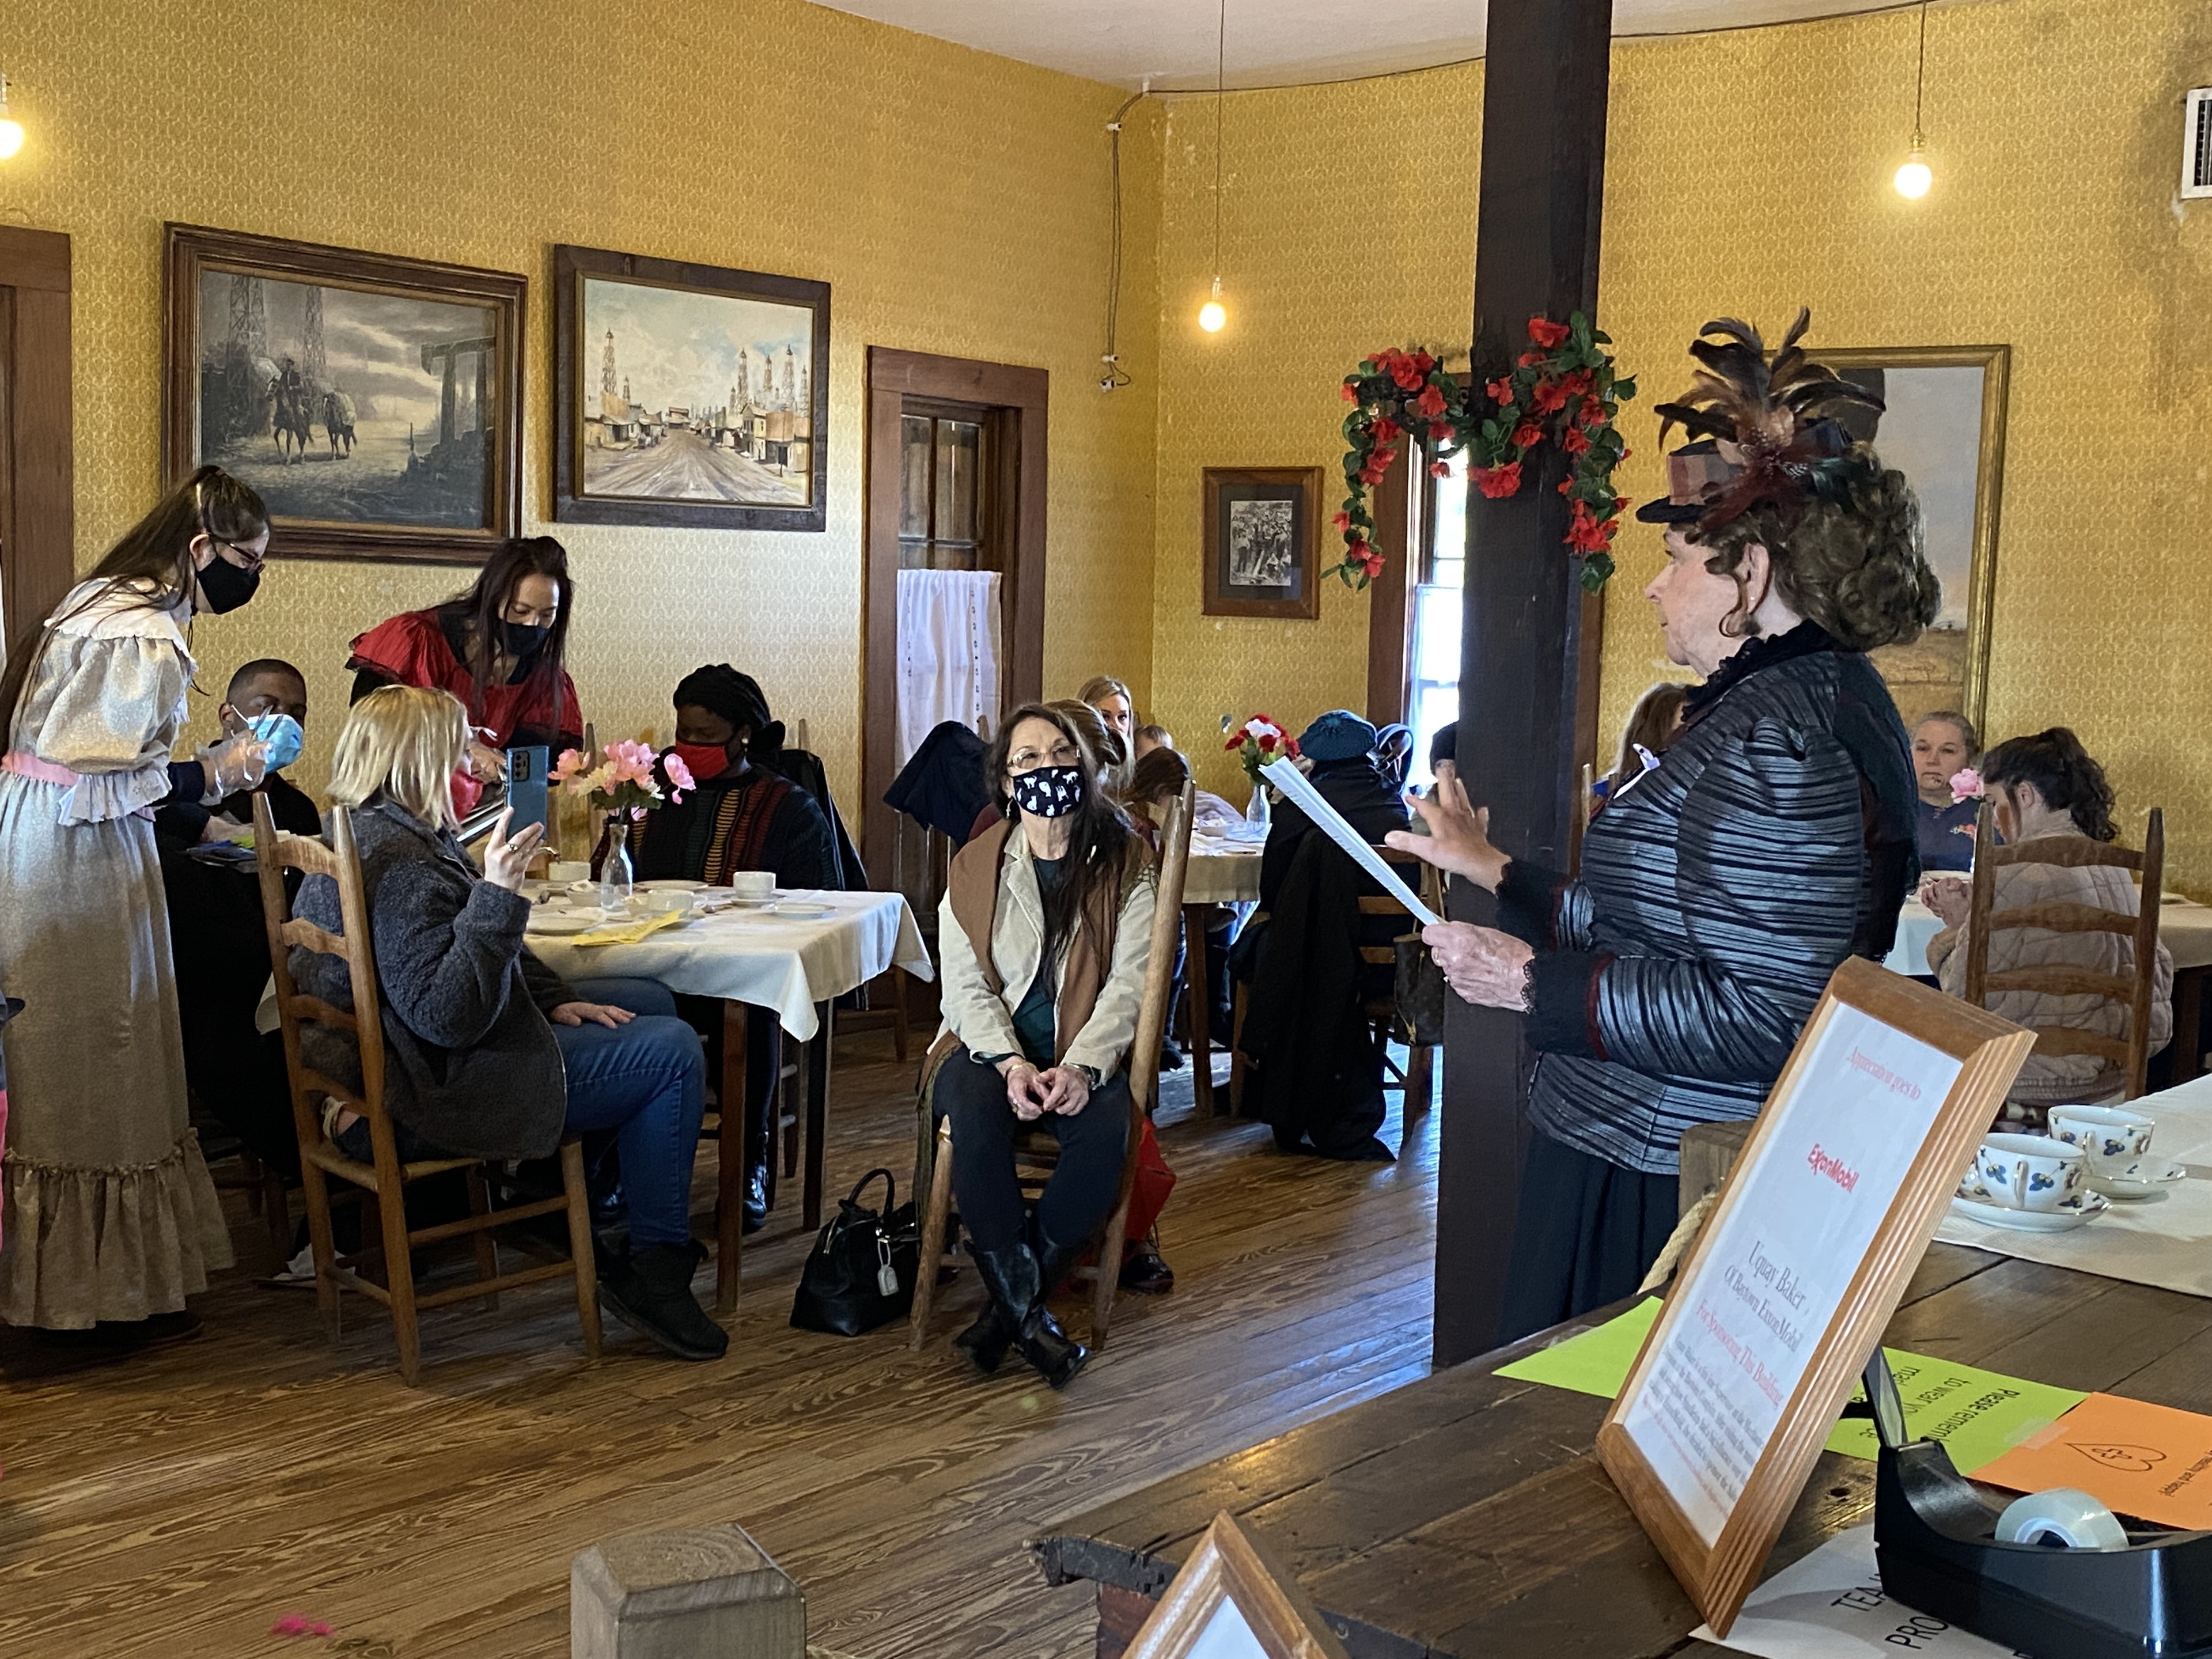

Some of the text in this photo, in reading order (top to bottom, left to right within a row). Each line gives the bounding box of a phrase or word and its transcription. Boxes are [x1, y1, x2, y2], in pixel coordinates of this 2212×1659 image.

[1807, 1143, 1859, 1193] ExxonMobil
[1775, 1267, 1806, 1310] Baker
[1758, 1298, 1804, 1354] ExxonMobil
[1916, 1386, 1955, 1404] wear
[1944, 1377, 1972, 1388] to
[1968, 1388, 2021, 1410] Please
[1831, 1586, 1887, 1612] TEA
